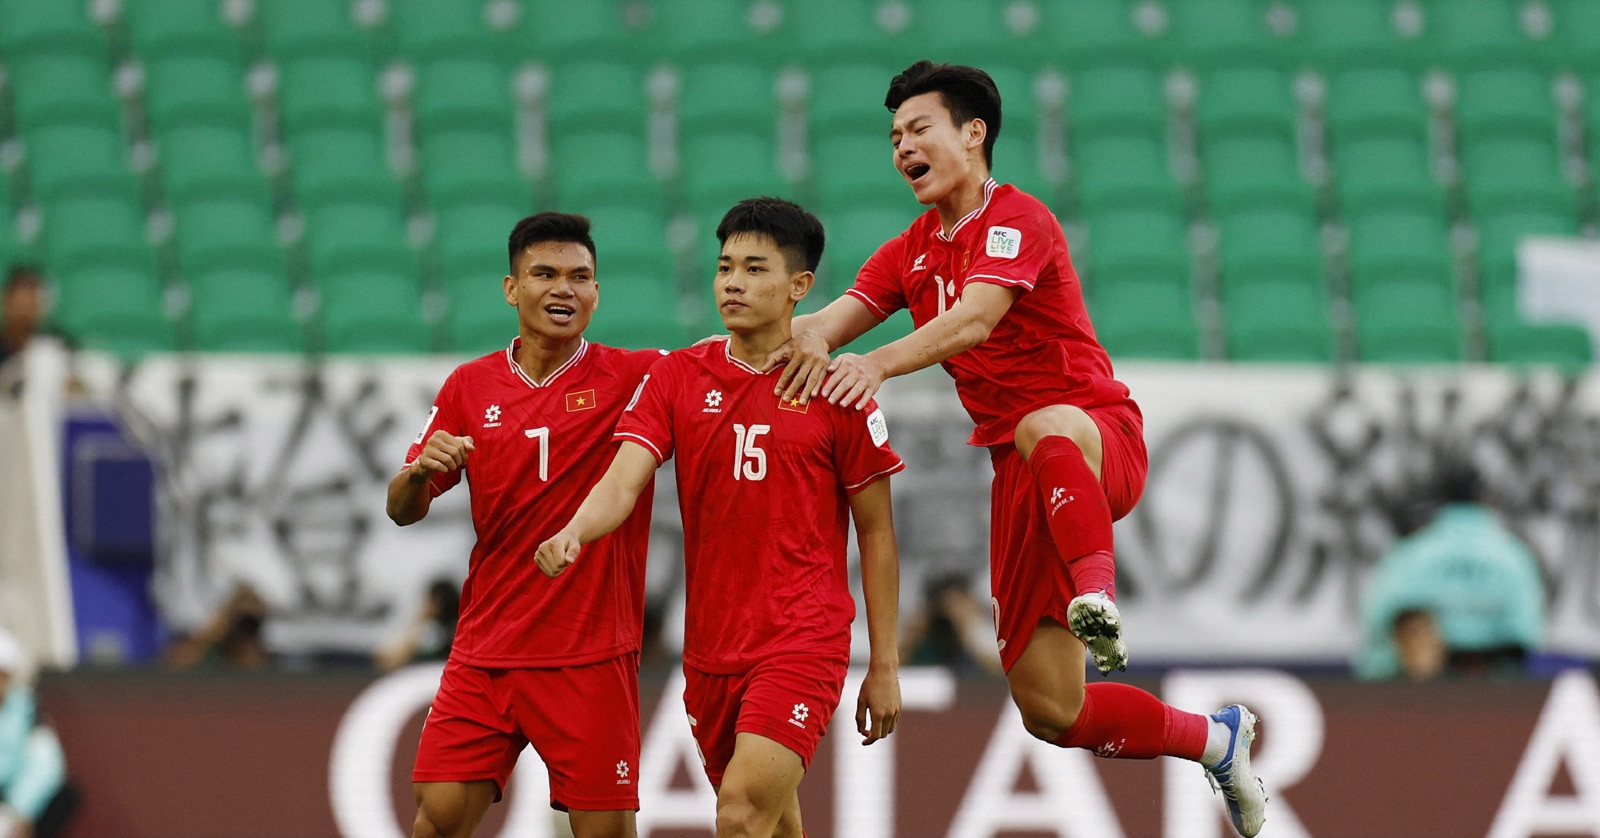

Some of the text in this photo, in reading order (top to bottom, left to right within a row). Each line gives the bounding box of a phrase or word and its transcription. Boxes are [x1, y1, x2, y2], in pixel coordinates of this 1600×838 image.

[991, 236, 1014, 247] LIVE
[993, 230, 1007, 238] AFC
[524, 426, 550, 482] 7
[732, 423, 771, 482] 15
